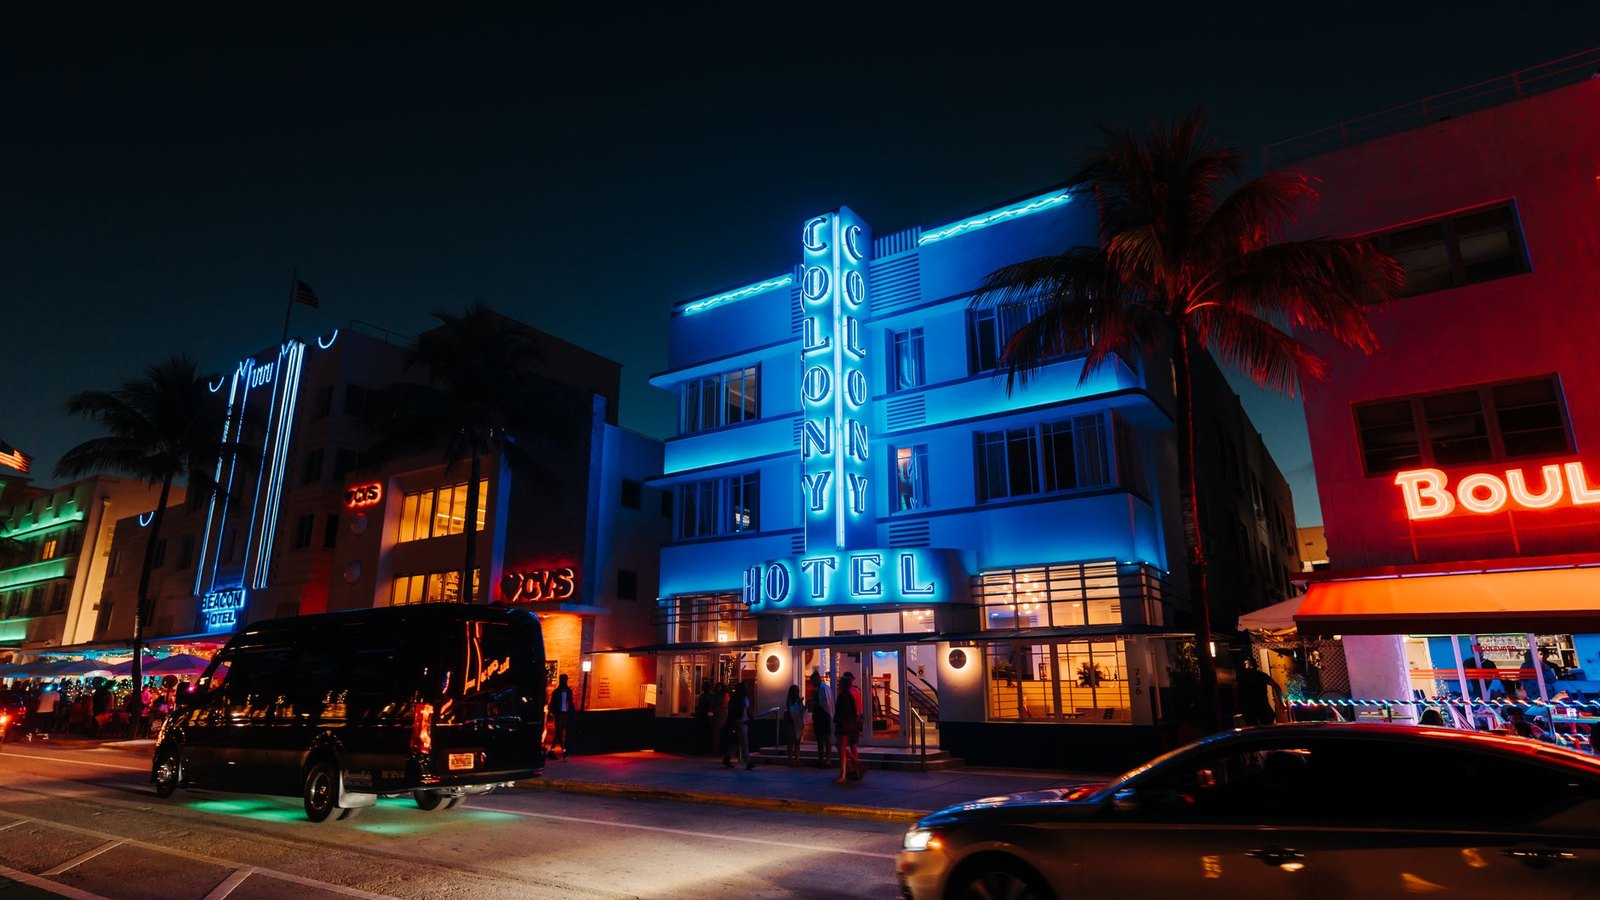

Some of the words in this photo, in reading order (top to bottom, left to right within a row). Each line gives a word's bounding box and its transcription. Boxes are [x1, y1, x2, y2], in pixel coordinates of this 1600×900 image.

[802, 217, 831, 511] COLONY
[845, 225, 868, 514] COLONY
[355, 484, 381, 504] CVS
[1394, 461, 1600, 520] BOUL
[522, 568, 575, 600] CVS
[743, 553, 935, 607] HOTEL
[202, 589, 245, 611] BEACON
[205, 611, 236, 625] HOTEL
[1134, 667, 1143, 696] 736
